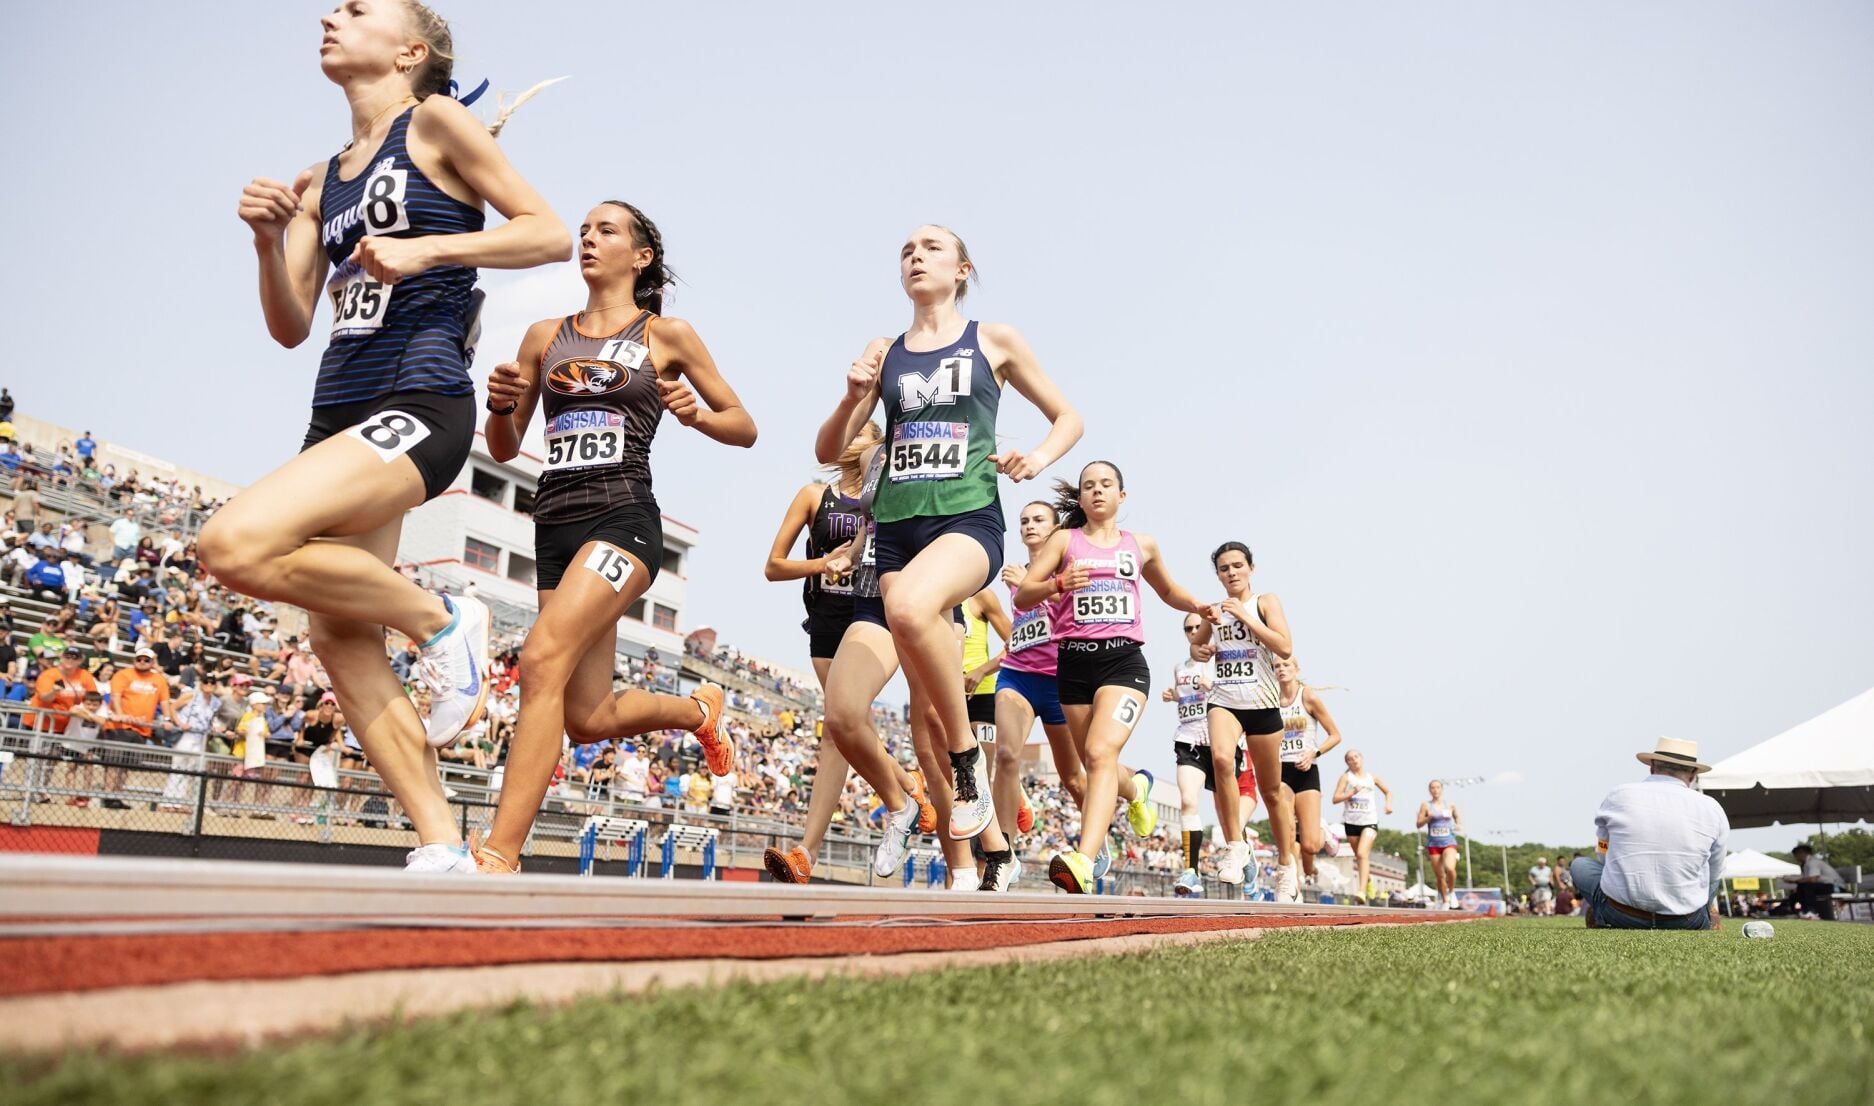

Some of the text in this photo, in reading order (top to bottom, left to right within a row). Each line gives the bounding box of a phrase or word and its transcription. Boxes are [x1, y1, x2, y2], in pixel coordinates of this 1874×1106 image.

[367, 175, 398, 229] 8
[610, 341, 638, 364] 15
[945, 359, 961, 393] 1
[898, 371, 957, 412] M
[360, 414, 417, 450] 8
[555, 411, 608, 433] MSHSAA
[901, 422, 952, 440] MSHSAA
[548, 431, 618, 465] 5763
[894, 443, 961, 472] 5544
[597, 548, 630, 583] 15
[1119, 553, 1134, 577] 5
[1077, 595, 1128, 616] 5531
[1012, 620, 1048, 647] 5492
[1233, 620, 1247, 640] 3
[1067, 641, 1099, 652] PRO
[1216, 661, 1254, 678] 5843
[1120, 698, 1138, 724] 5
[981, 726, 994, 742] 10
[1280, 739, 1304, 751] 319
